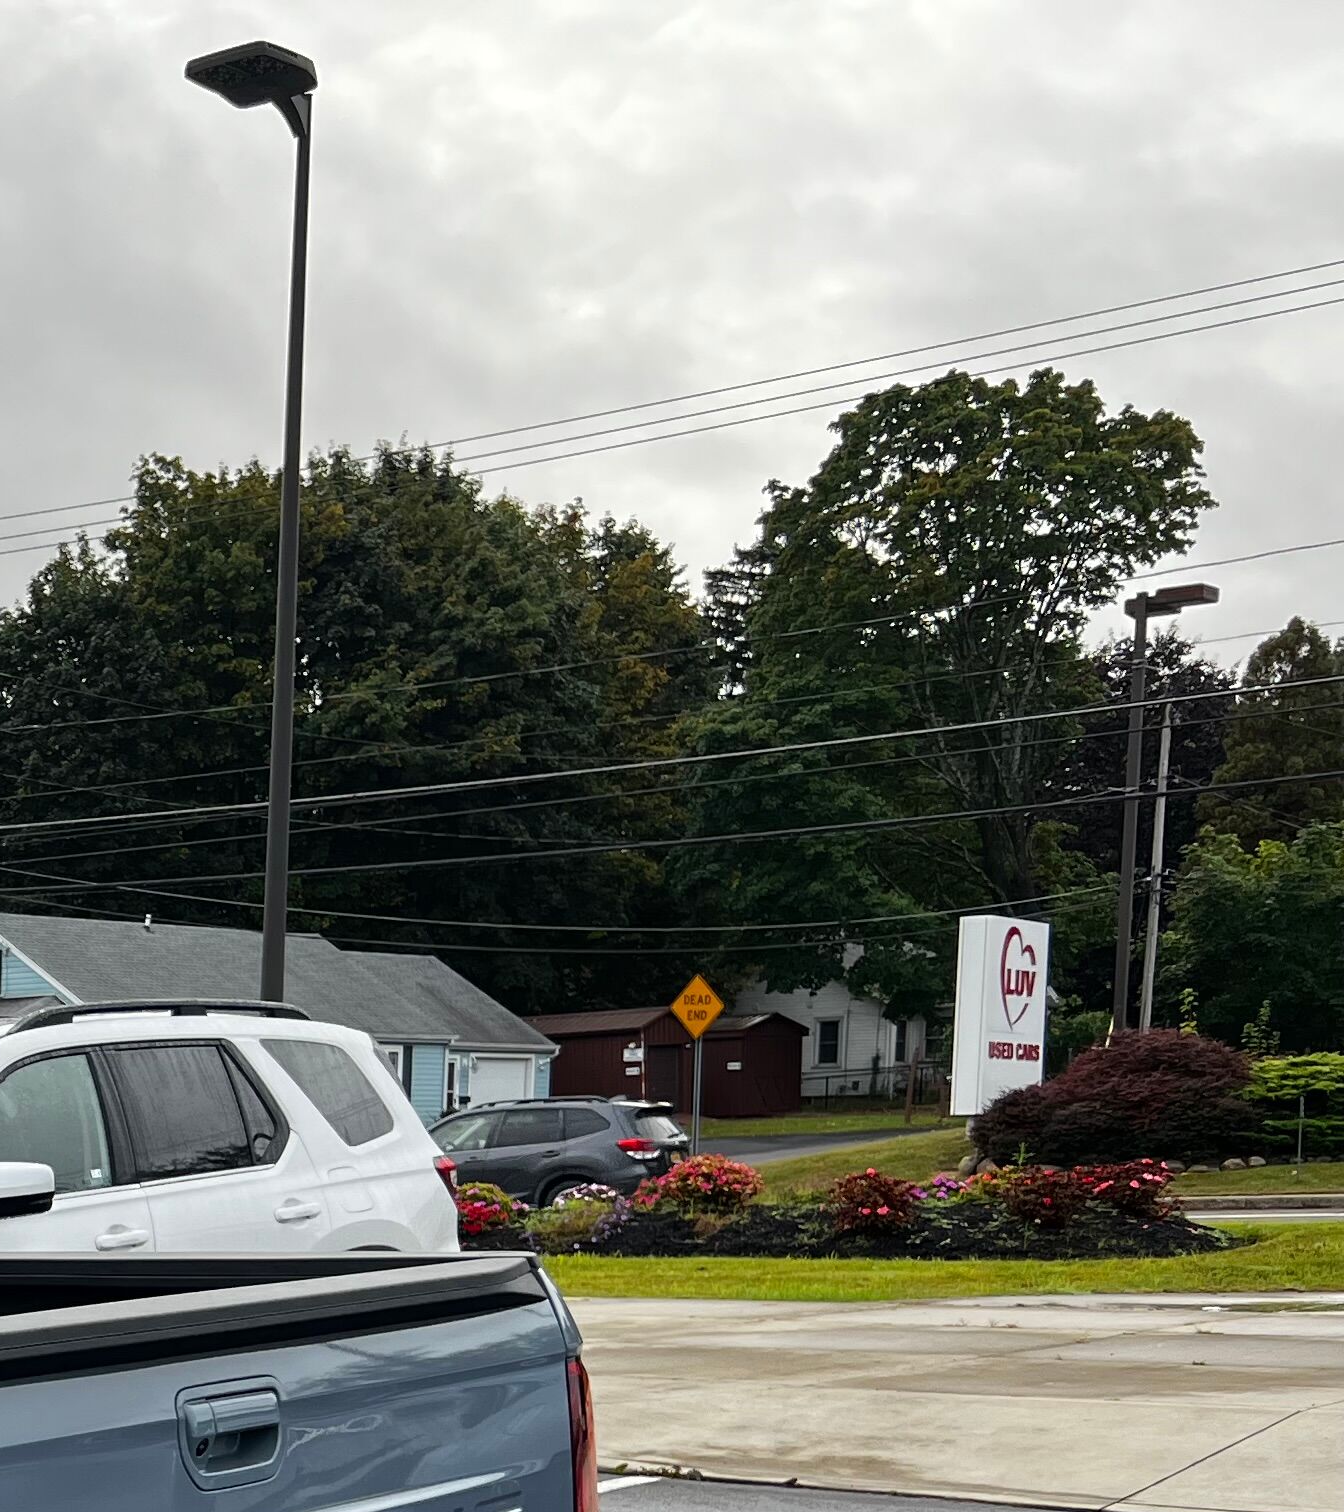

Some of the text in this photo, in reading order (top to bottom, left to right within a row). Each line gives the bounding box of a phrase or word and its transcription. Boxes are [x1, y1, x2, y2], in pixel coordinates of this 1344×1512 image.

[1005, 968, 1036, 997] LUV
[683, 994, 712, 1006] DEAD
[687, 1010, 707, 1021] END
[988, 1041, 1040, 1061] USED CARS
